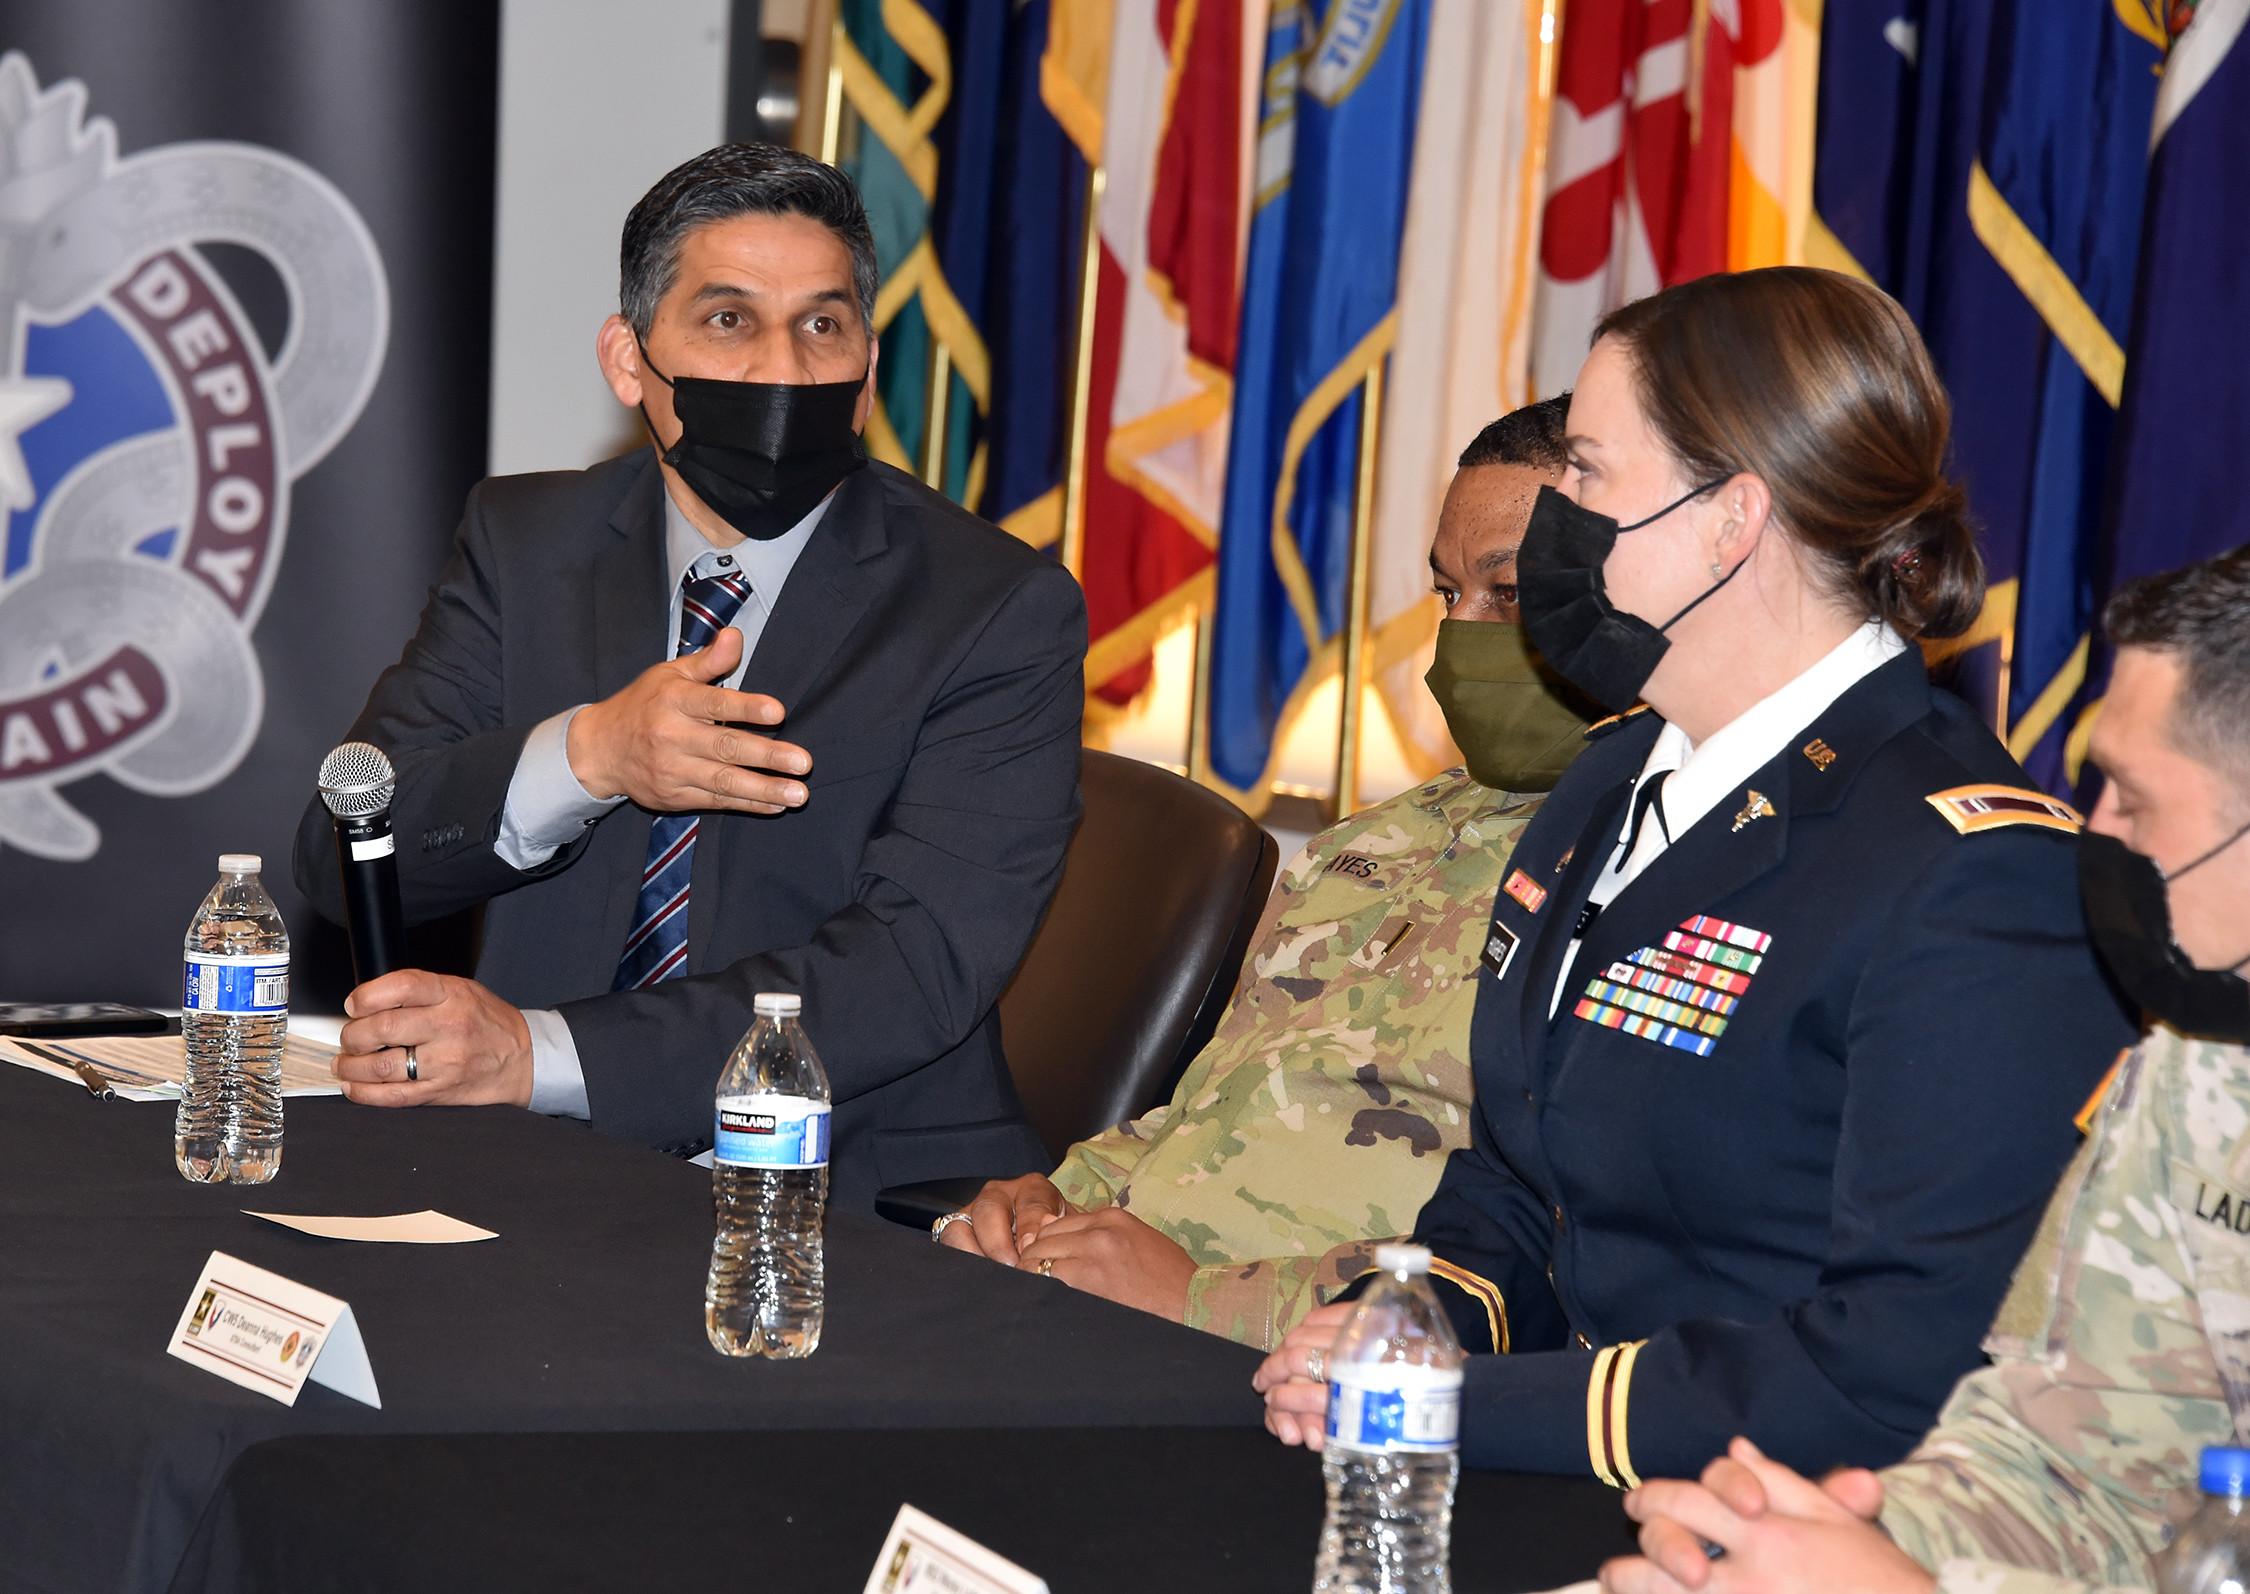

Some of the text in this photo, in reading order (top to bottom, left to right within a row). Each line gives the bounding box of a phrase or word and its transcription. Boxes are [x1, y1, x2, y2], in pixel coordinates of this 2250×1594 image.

[131, 254, 264, 598] DEPLOY
[2, 667, 149, 769] AIN
[722, 1113, 775, 1129] KIRKLAND
